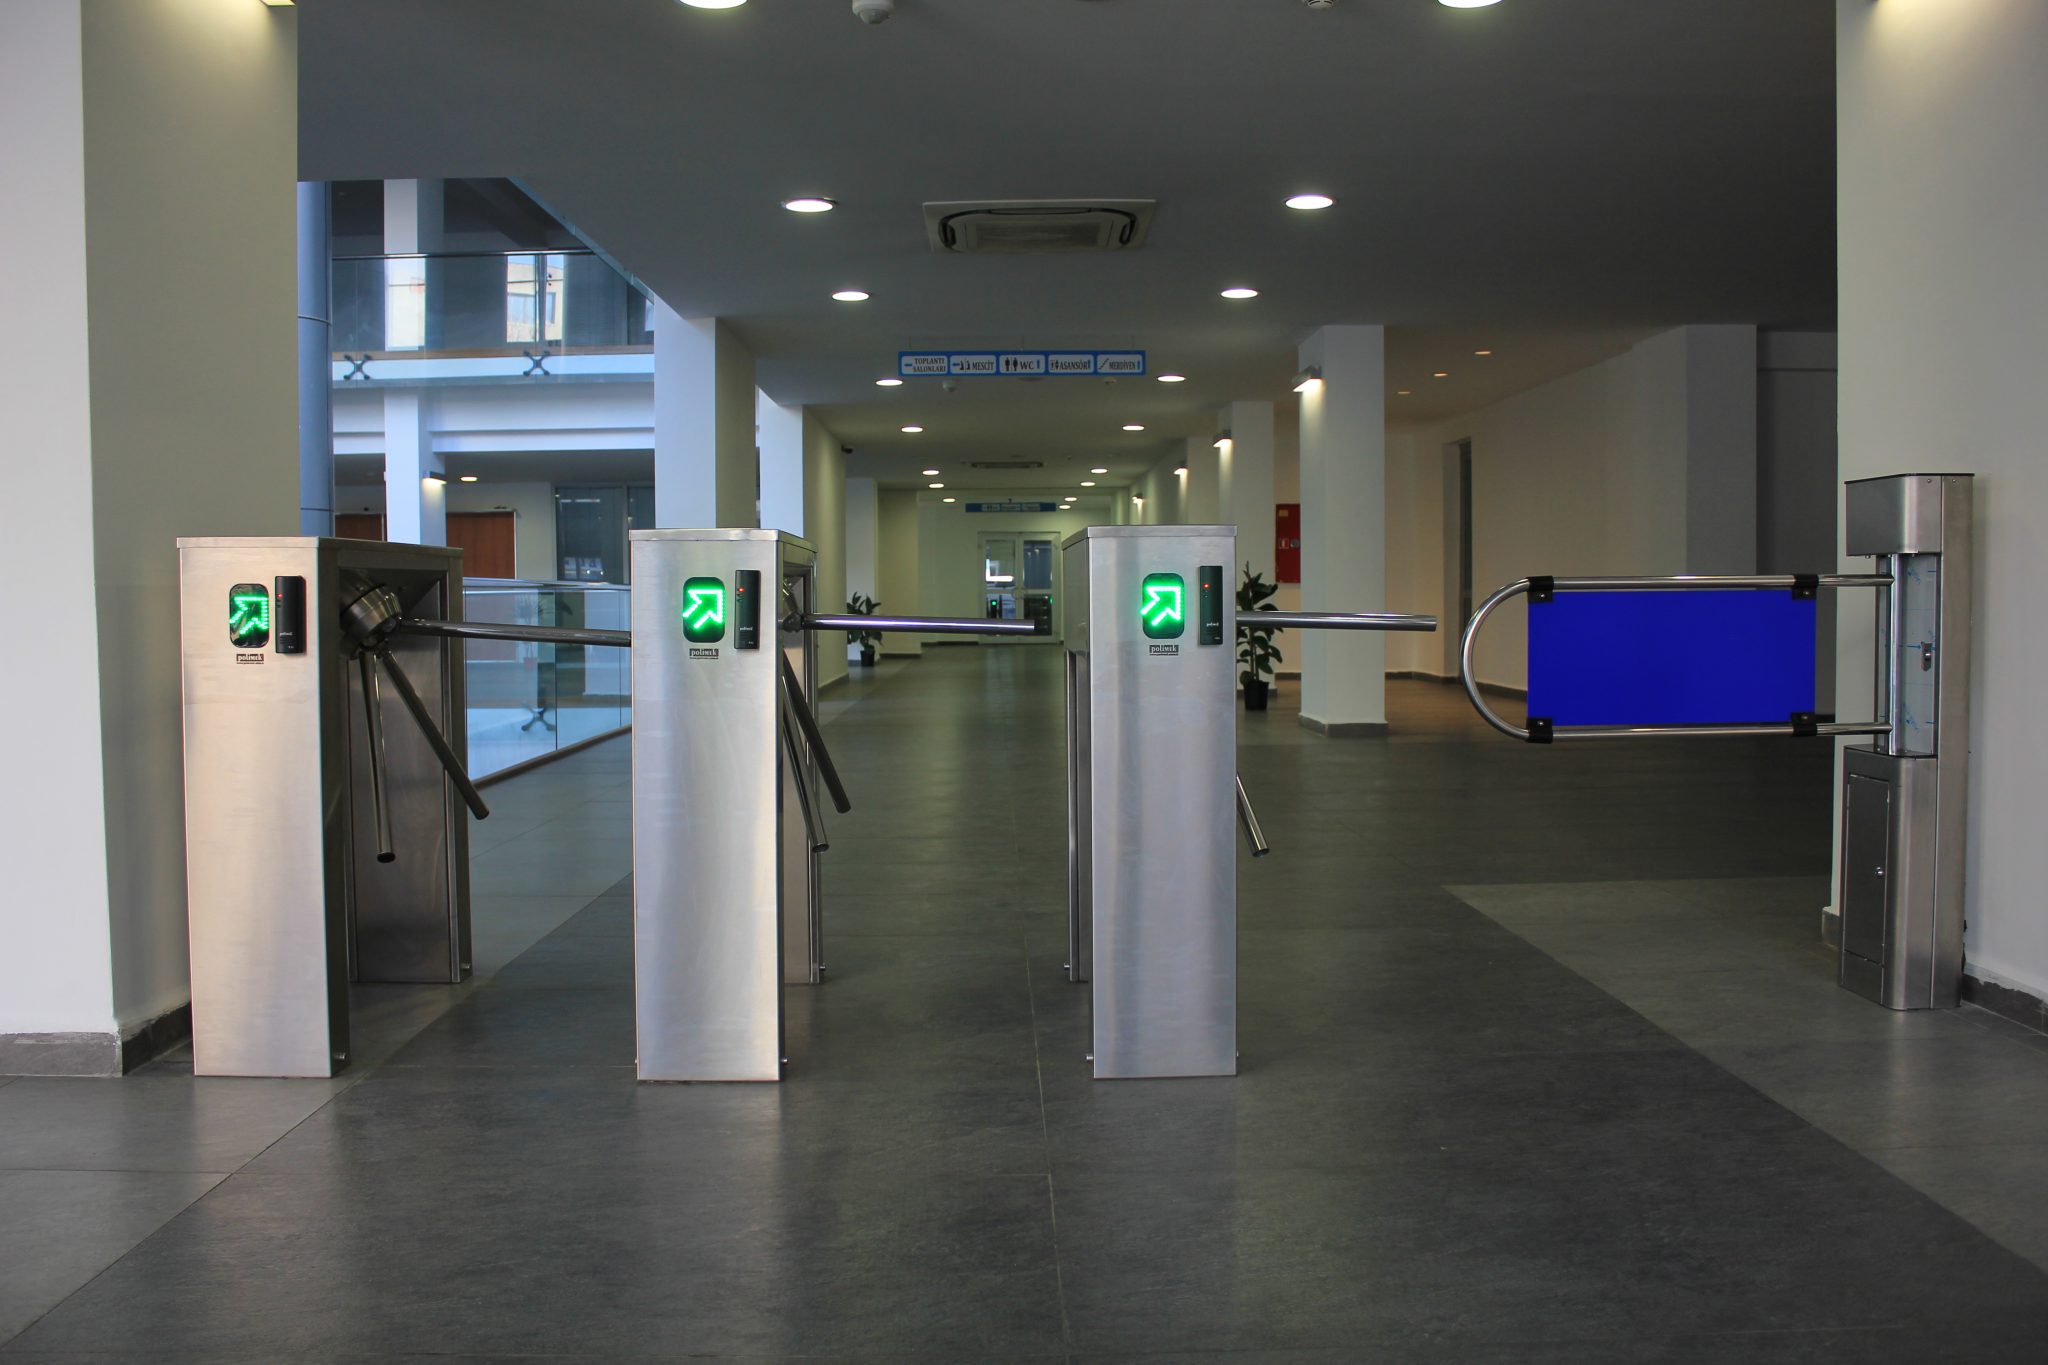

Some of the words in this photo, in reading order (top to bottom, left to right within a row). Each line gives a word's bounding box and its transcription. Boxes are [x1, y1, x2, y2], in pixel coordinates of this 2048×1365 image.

[972, 361, 994, 370] MESCİT
[1020, 361, 1034, 370] WC
[1060, 360, 1088, 370] ASANSÖR
[1109, 360, 1136, 370] MERDİVEN
